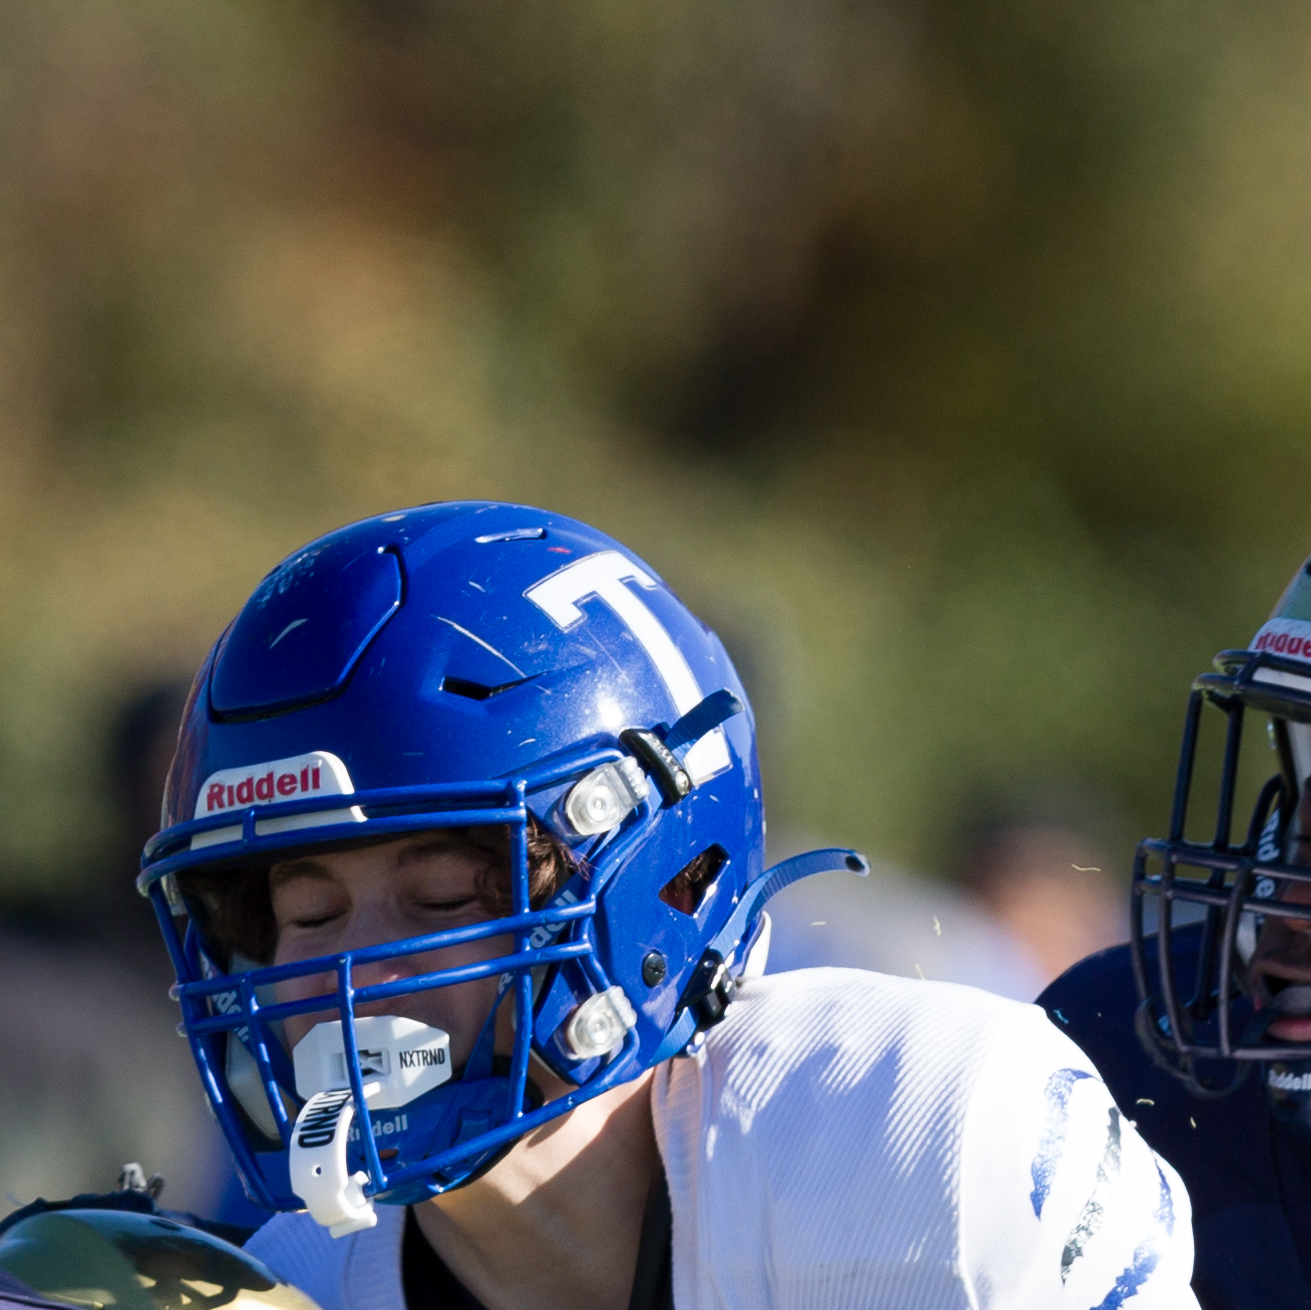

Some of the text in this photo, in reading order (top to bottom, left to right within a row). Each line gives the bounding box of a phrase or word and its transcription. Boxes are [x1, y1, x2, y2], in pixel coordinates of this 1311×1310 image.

[524, 549, 733, 782] T
[206, 759, 321, 811] Riddell
[399, 1047, 446, 1069] NXTRND
